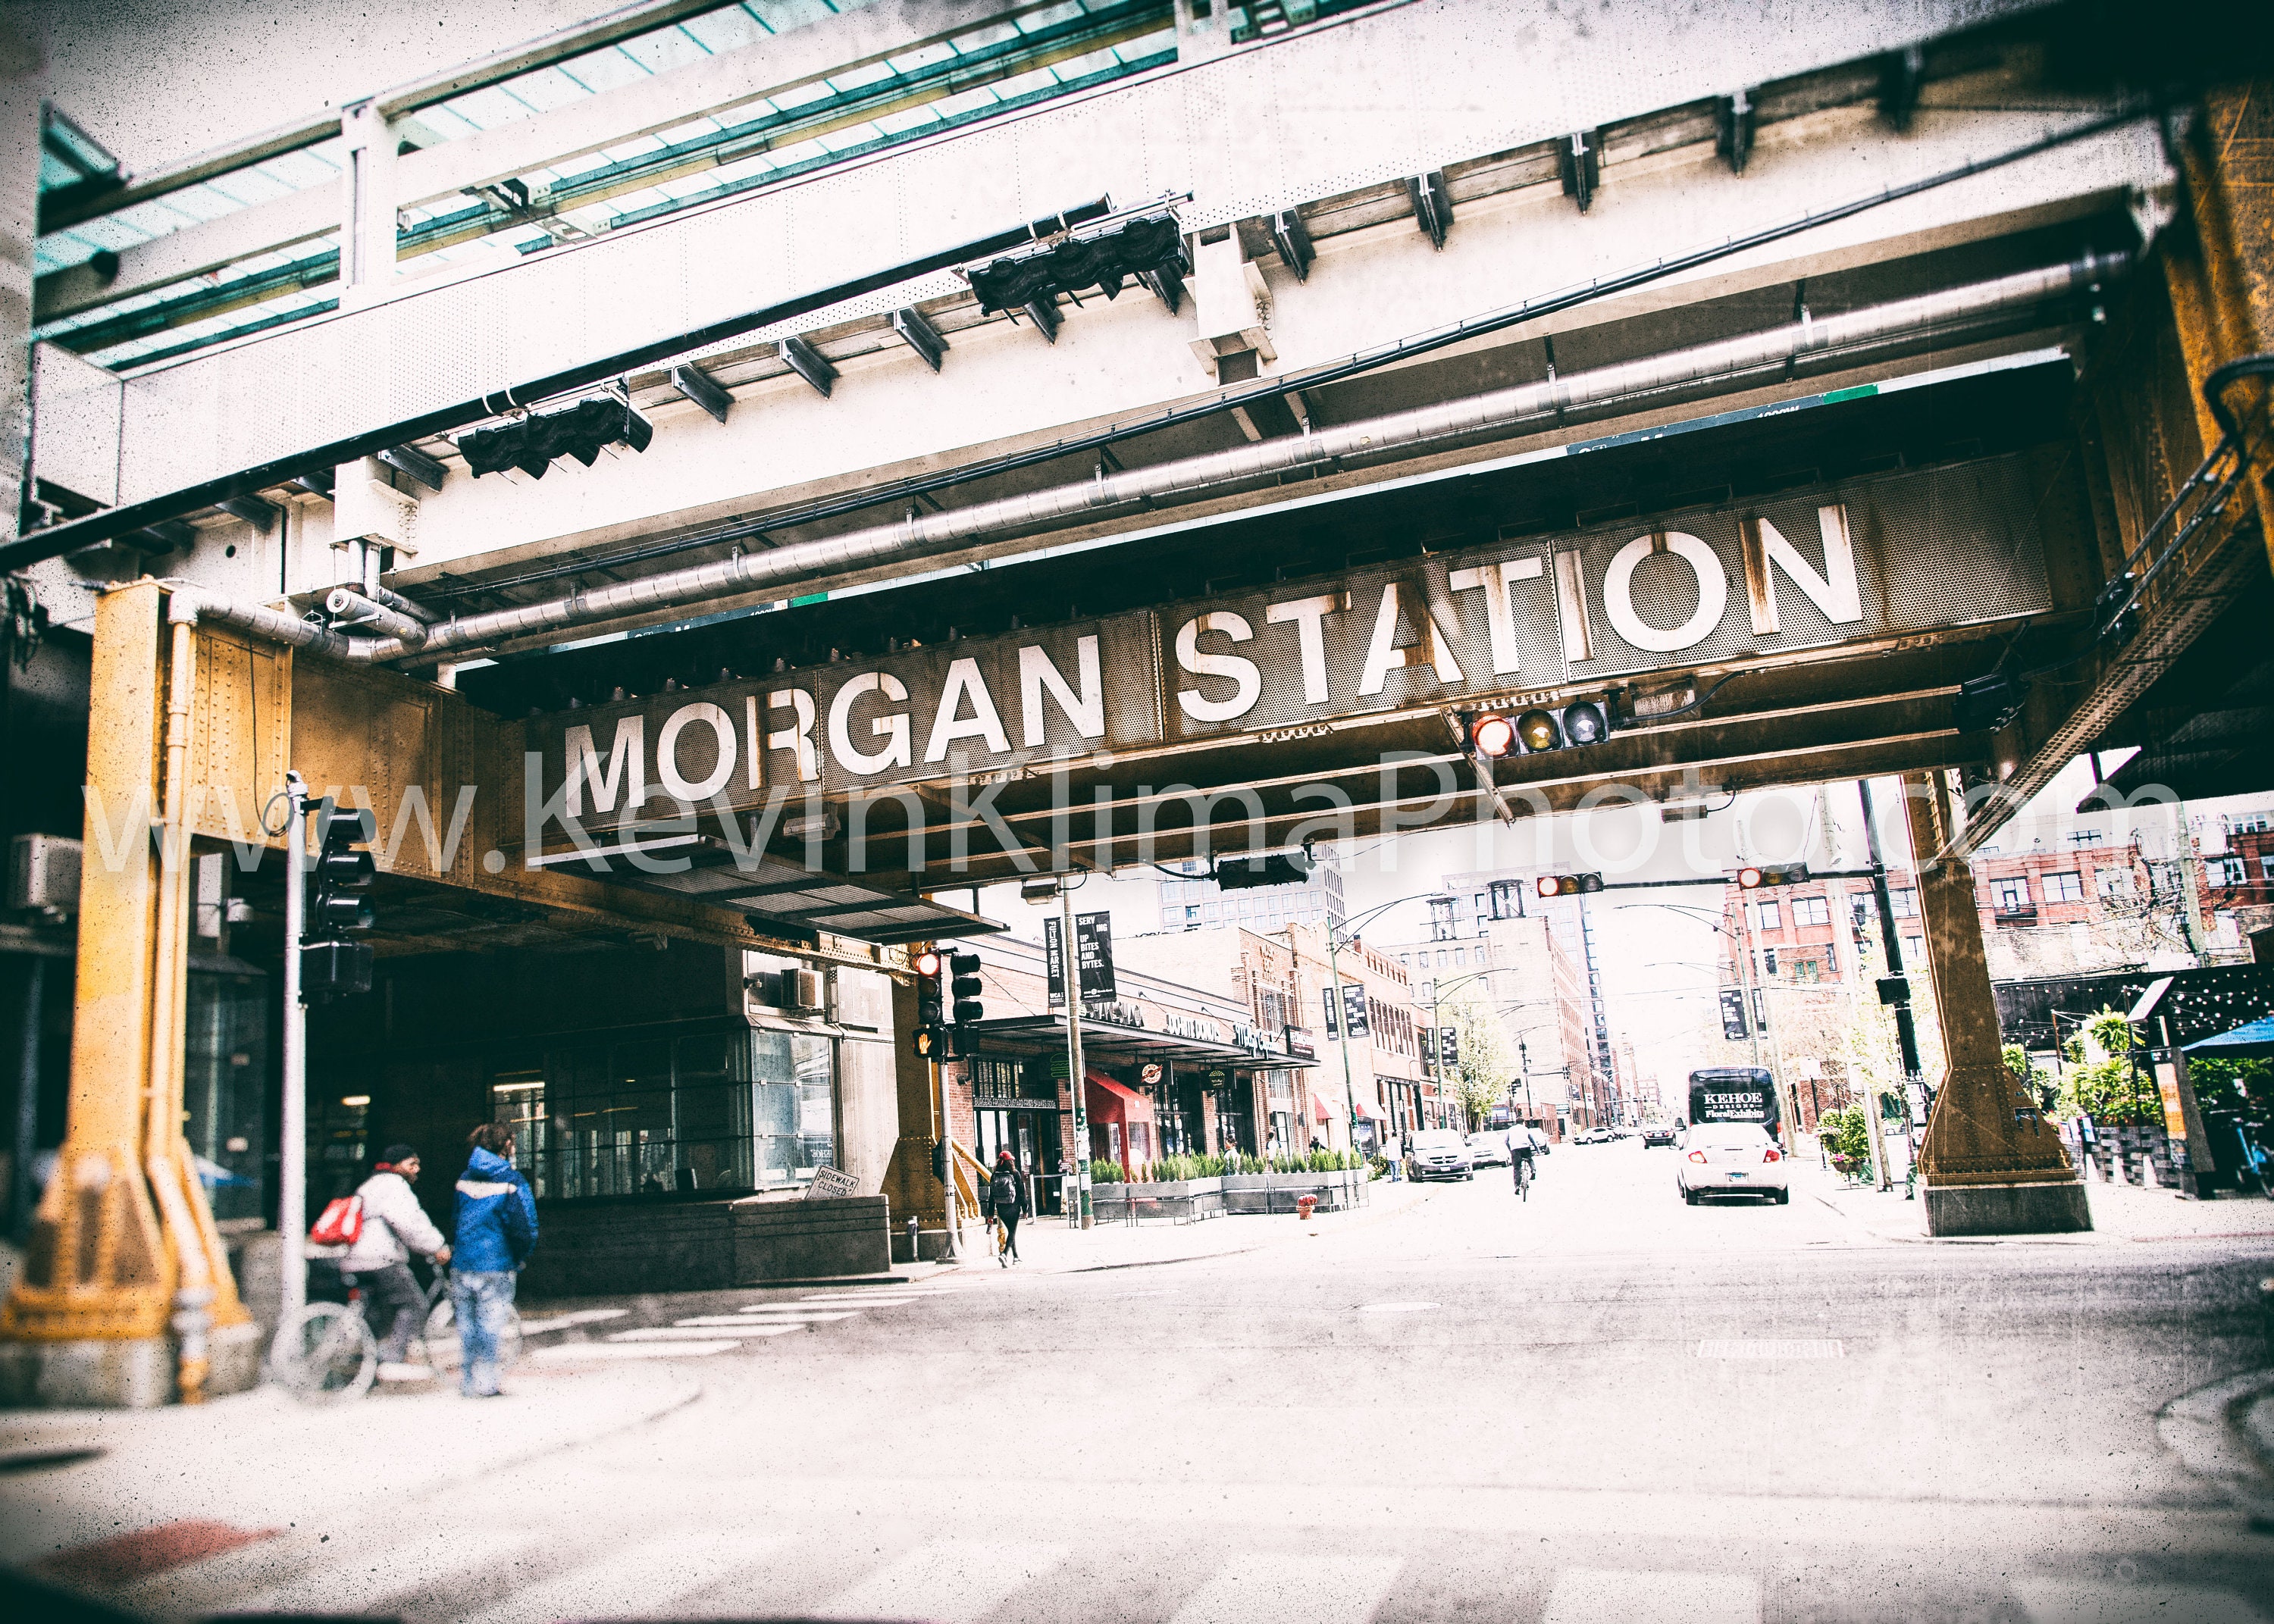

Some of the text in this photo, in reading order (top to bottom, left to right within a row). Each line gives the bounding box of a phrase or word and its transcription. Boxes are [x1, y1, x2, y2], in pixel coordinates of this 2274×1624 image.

[565, 503, 1864, 818] MORGAN STATION
[1079, 916, 1095, 925] SERV
[1096, 924, 1108, 932] ING
[1079, 934, 1089, 943] UP
[1048, 921, 1060, 978] FULTON MARKET
[1080, 943, 1099, 952] BITES
[1081, 951, 1095, 960] AND
[1082, 959, 1104, 969] BYTES.
[974, 1097, 992, 1106] BURGERS
[1703, 1092, 1763, 1104] KEHOE
[819, 1170, 856, 1188] SIDEWALK
[818, 1181, 847, 1197] CLOSED
